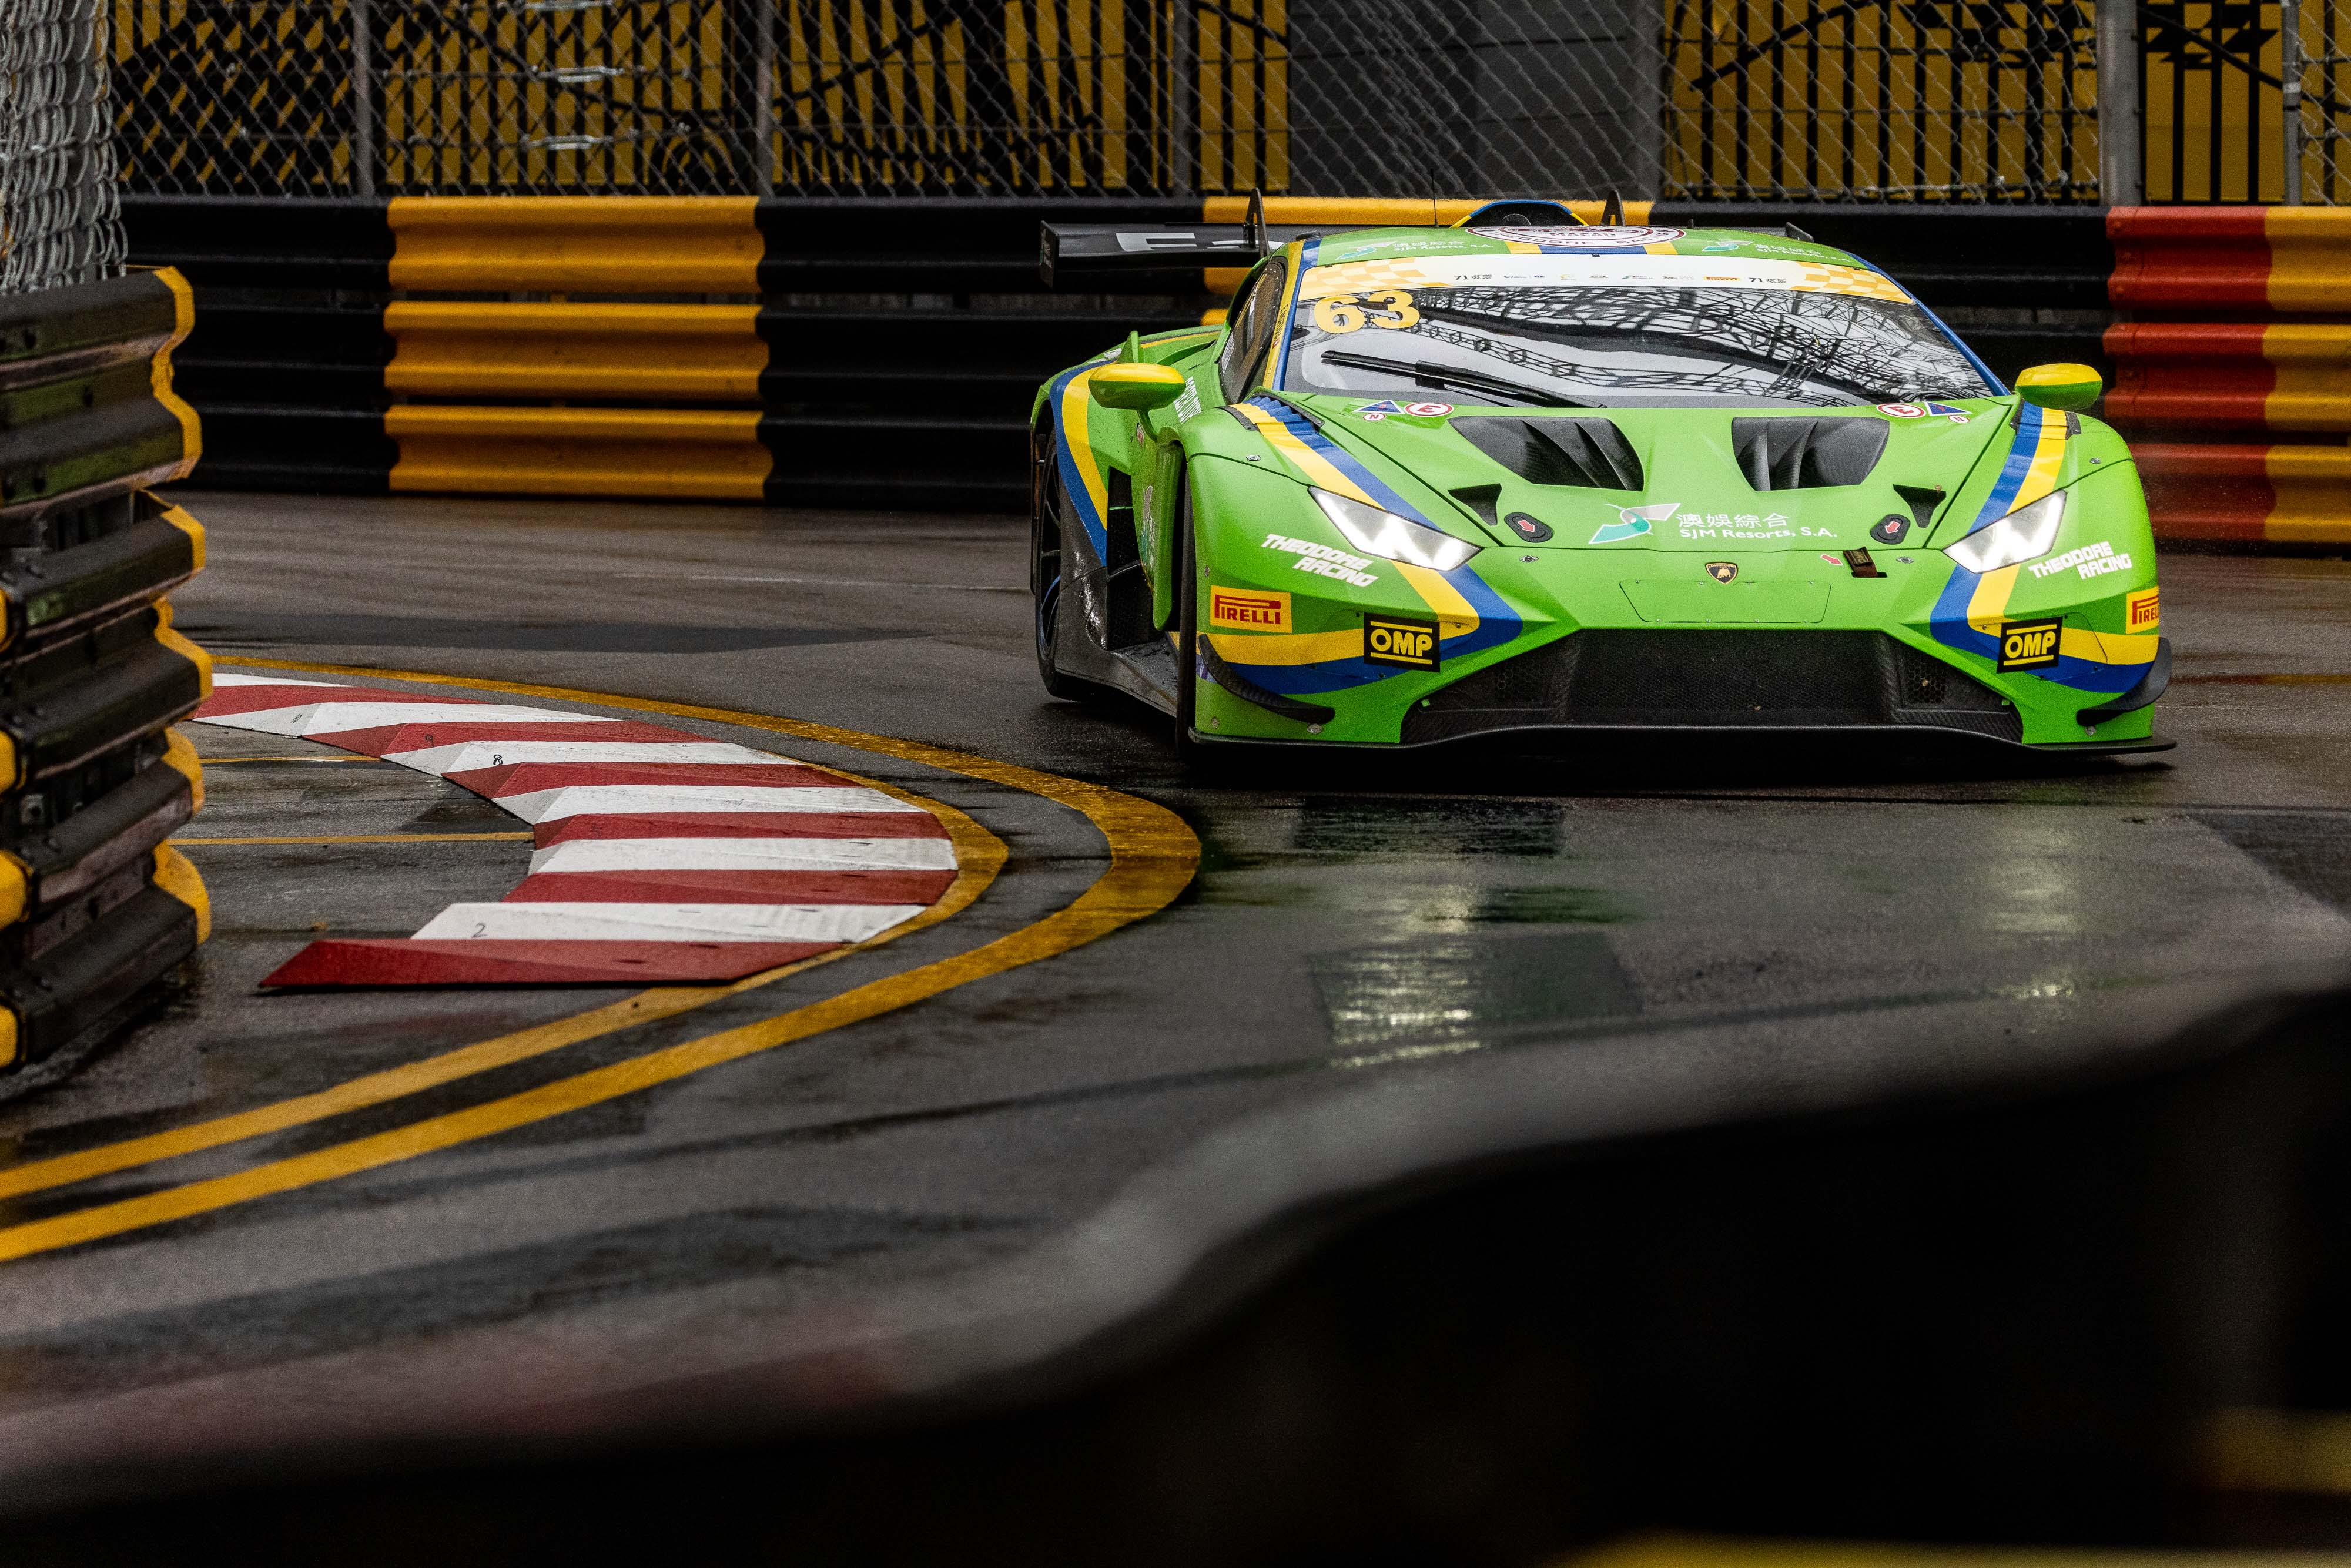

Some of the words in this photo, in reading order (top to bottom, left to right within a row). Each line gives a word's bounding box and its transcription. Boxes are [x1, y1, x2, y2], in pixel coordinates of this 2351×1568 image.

[1314, 290, 1420, 334] 63
[1417, 404, 1441, 413] E
[1677, 512, 1789, 528] 澳娛綜合
[1680, 528, 1717, 540] SJM
[1723, 528, 1796, 538] Resorts,
[1800, 526, 1837, 538] S.A.
[1261, 534, 1374, 571] THEODORE
[2028, 541, 2114, 579] THEODORE
[2077, 553, 2132, 580] RACING
[1293, 556, 1379, 587] RACING
[1214, 594, 1282, 625] PIRELLI
[1370, 628, 1432, 657] OMP
[2005, 631, 2056, 659] OMP
[492, 754, 503, 766] 8
[472, 922, 487, 938] 2
